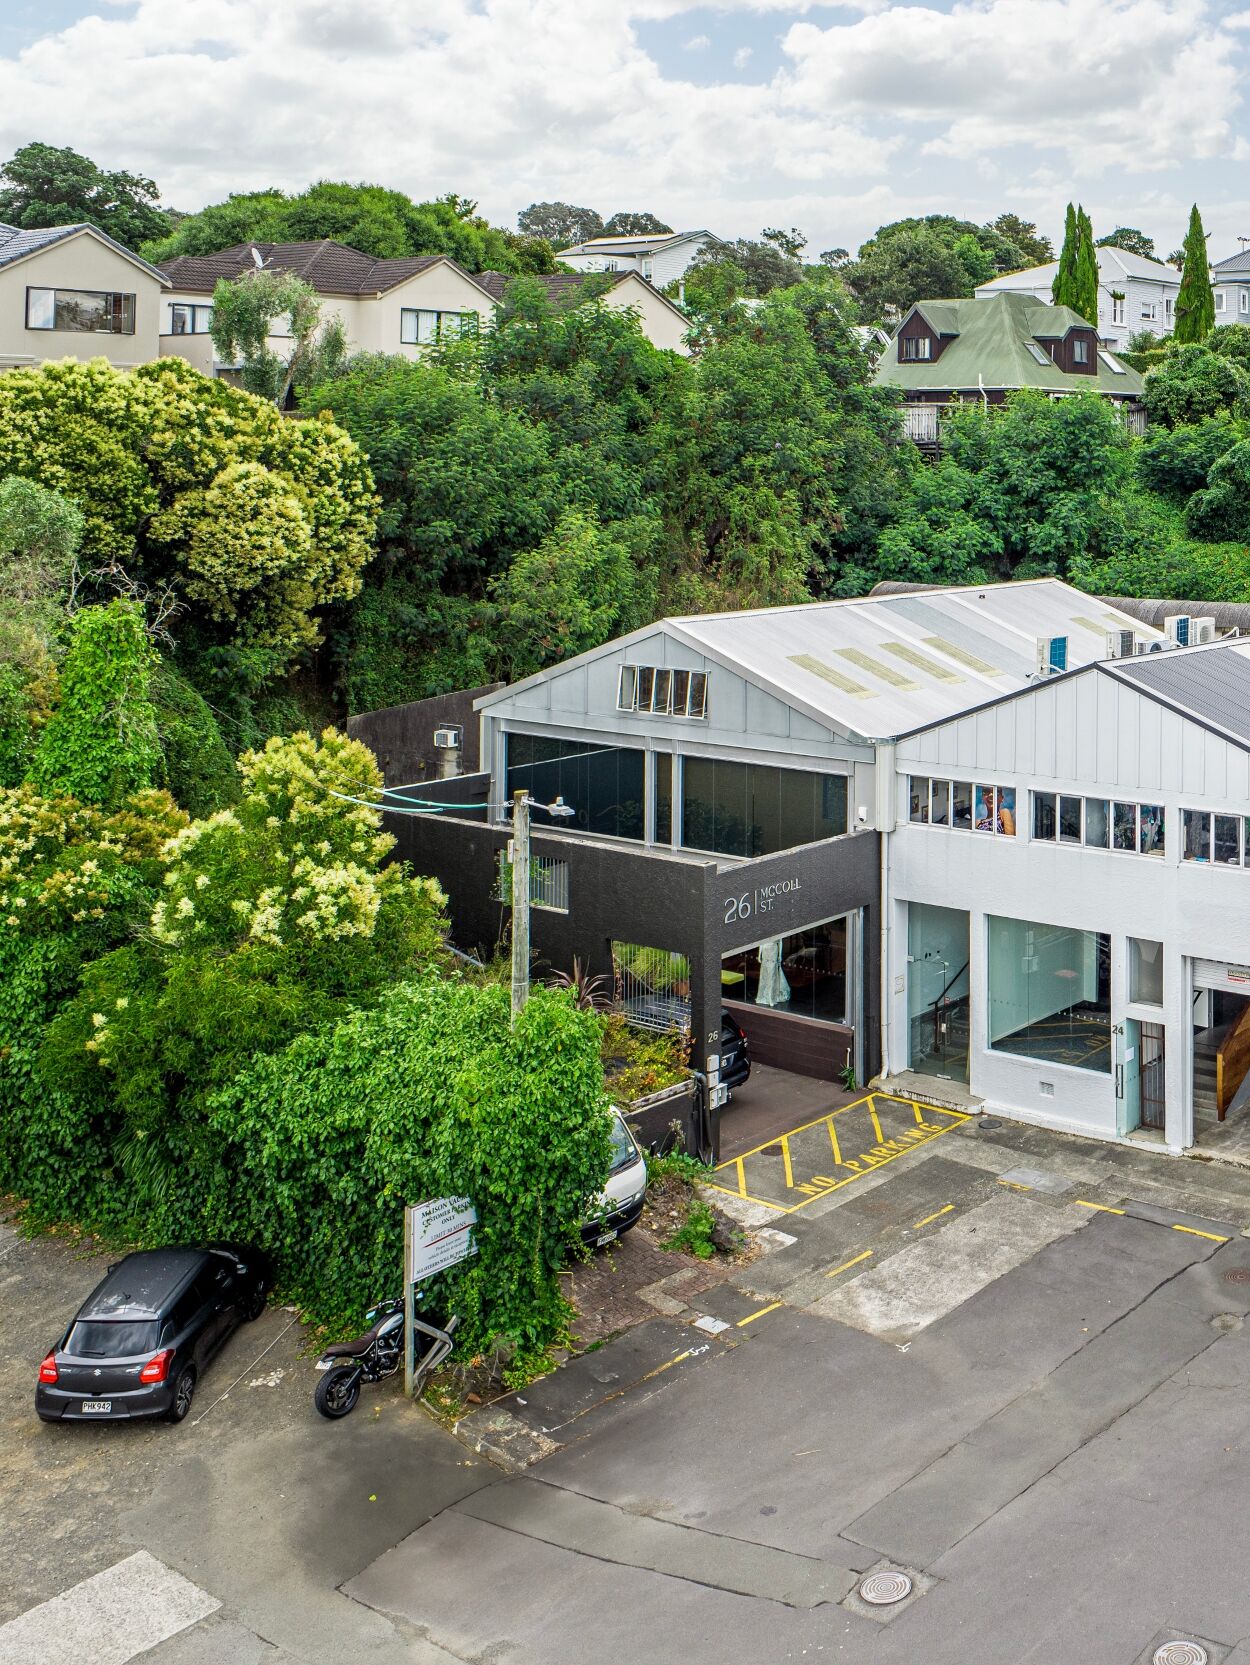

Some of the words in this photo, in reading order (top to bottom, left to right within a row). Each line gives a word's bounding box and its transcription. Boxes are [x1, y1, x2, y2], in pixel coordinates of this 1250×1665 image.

[760, 878, 802, 899] MCCOLL
[724, 892, 751, 924] 26
[760, 898, 774, 913] ST.
[707, 1030, 719, 1043] 26
[1112, 1024, 1125, 1036] 24
[794, 1176, 836, 1195] NO
[842, 1122, 943, 1172] PARKING
[83, 1402, 110, 1411] PHK942
